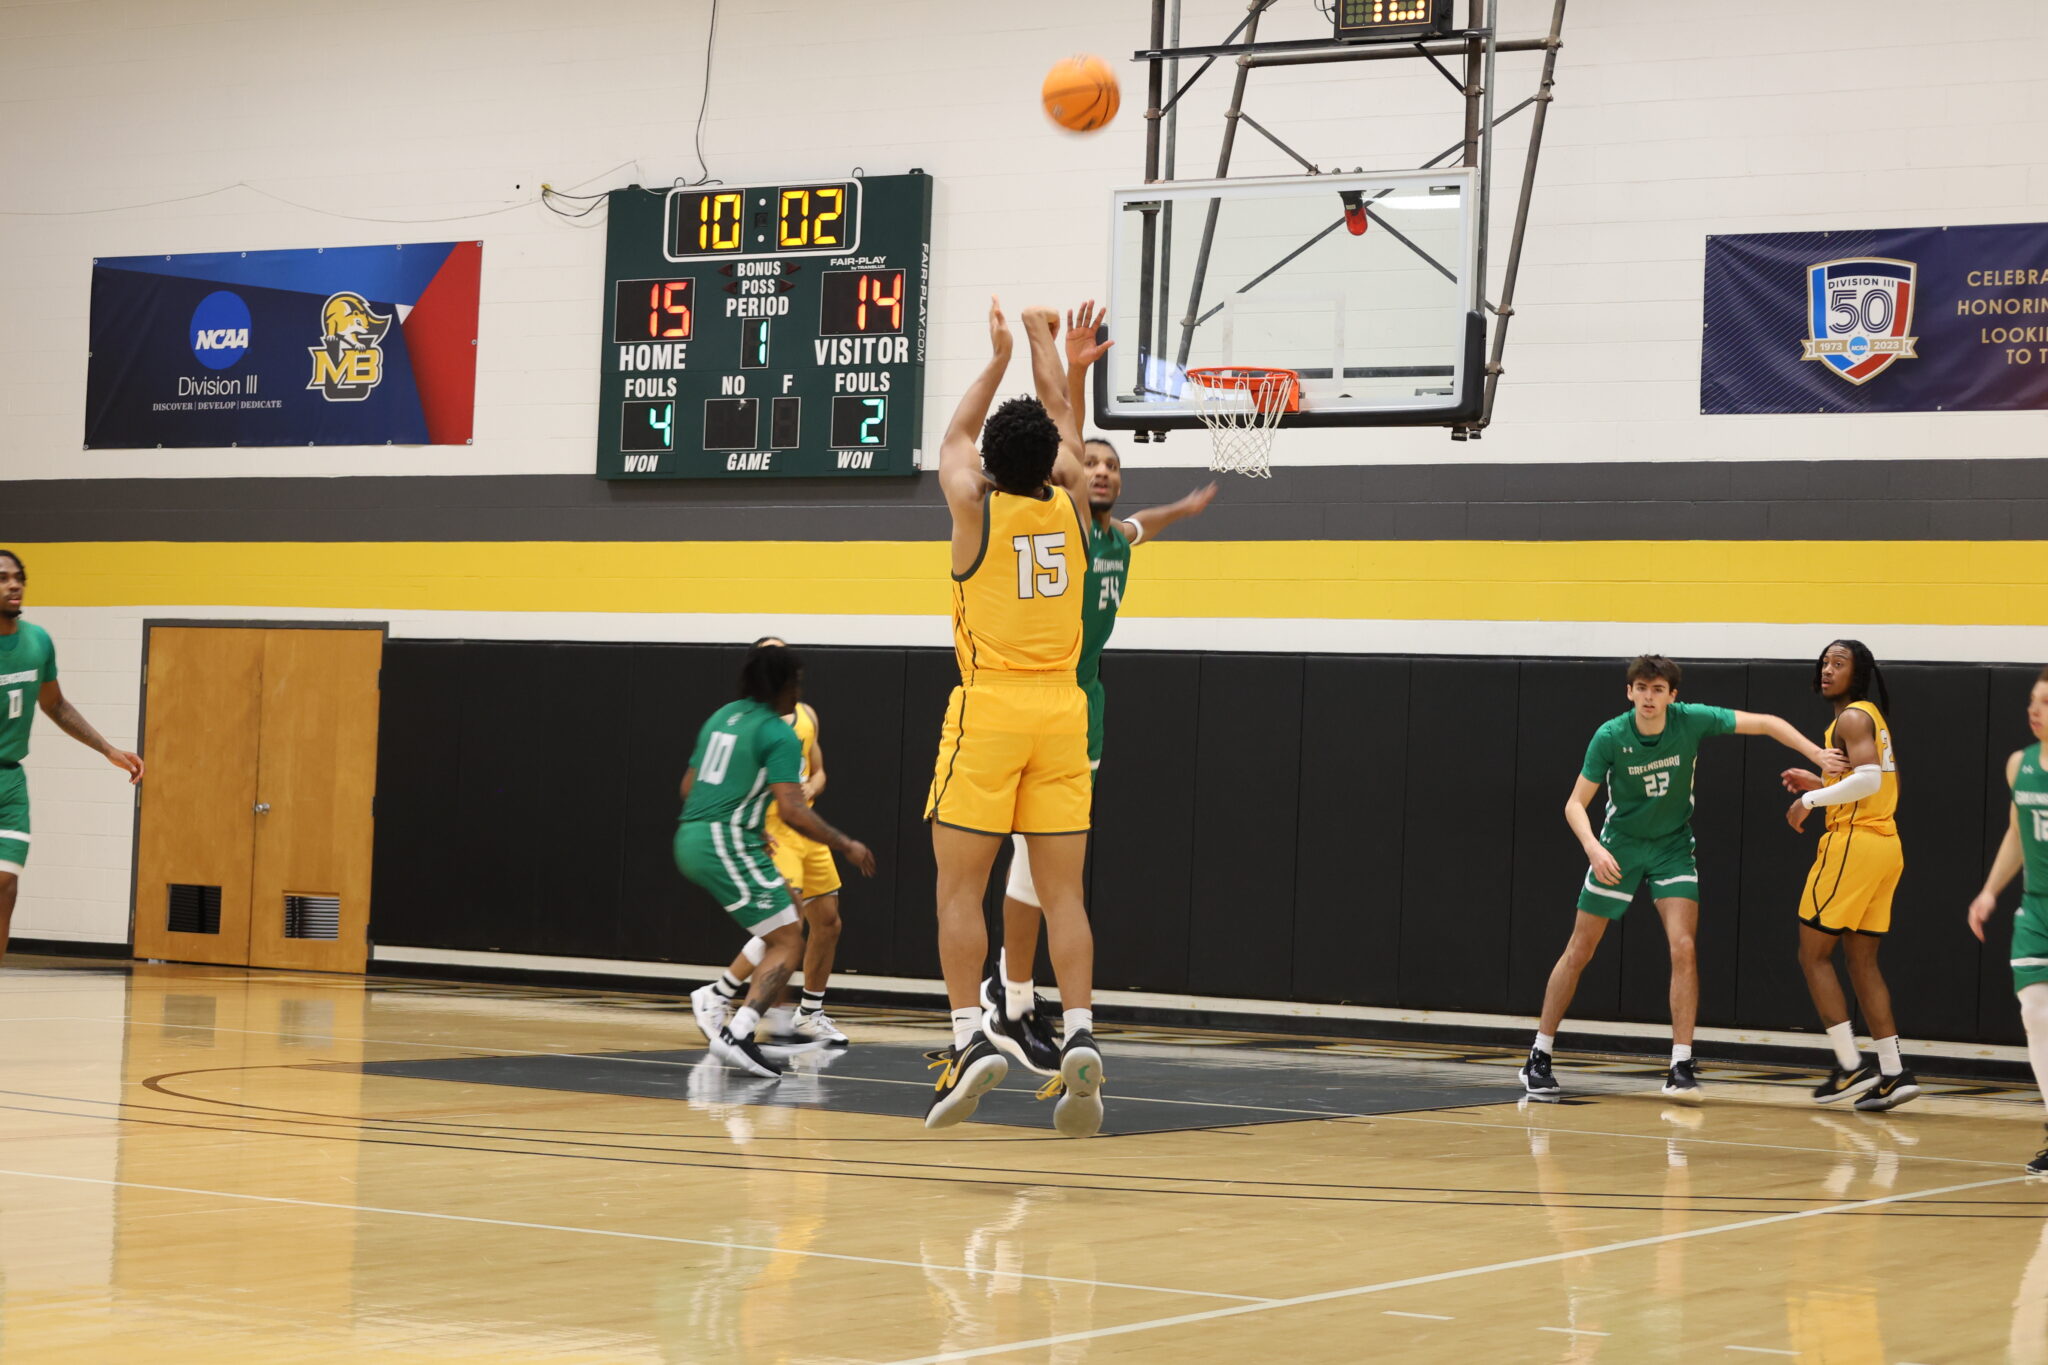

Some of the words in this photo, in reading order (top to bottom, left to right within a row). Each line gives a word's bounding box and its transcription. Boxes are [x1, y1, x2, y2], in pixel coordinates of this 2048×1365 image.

[737, 261, 781, 277] BONUS
[830, 256, 886, 266] FAIR-PLAY
[741, 279, 776, 295] POSS
[1828, 278, 1879, 290] DIVISION
[1883, 279, 1895, 288] III
[649, 281, 690, 338] 15
[726, 296, 790, 318] PERIOD
[857, 273, 902, 331] 14
[917, 242, 929, 362] FAIR-PLAY.COM
[1829, 289, 1894, 334] 50
[195, 328, 249, 350] NCAA
[758, 321, 768, 365] 1
[1873, 341, 1900, 350] 2023
[1981, 326, 2048, 344] LOOKI
[619, 343, 687, 372] HOME
[814, 337, 909, 366] VISITOR
[1819, 342, 1843, 351] 1973
[2006, 348, 2032, 365] TO
[178, 376, 241, 396] Division
[246, 374, 258, 394] III
[624, 377, 678, 398] FOULS
[721, 375, 746, 395] NO
[782, 374, 794, 393] F
[834, 371, 891, 393] FOULS
[152, 402, 193, 411] DISCOVER
[197, 401, 236, 410] DEVELOP
[240, 400, 282, 409] DEDICATE
[649, 403, 672, 447] 4
[860, 398, 885, 444] 2
[624, 455, 659, 473] WON
[726, 452, 772, 471] GAME
[837, 451, 874, 469] WON
[1012, 531, 1069, 599] 15
[1098, 576, 1120, 610] 24
[696, 731, 738, 785] 10
[1627, 754, 1680, 776] GREENSBORO
[1642, 771, 1670, 798] 22
